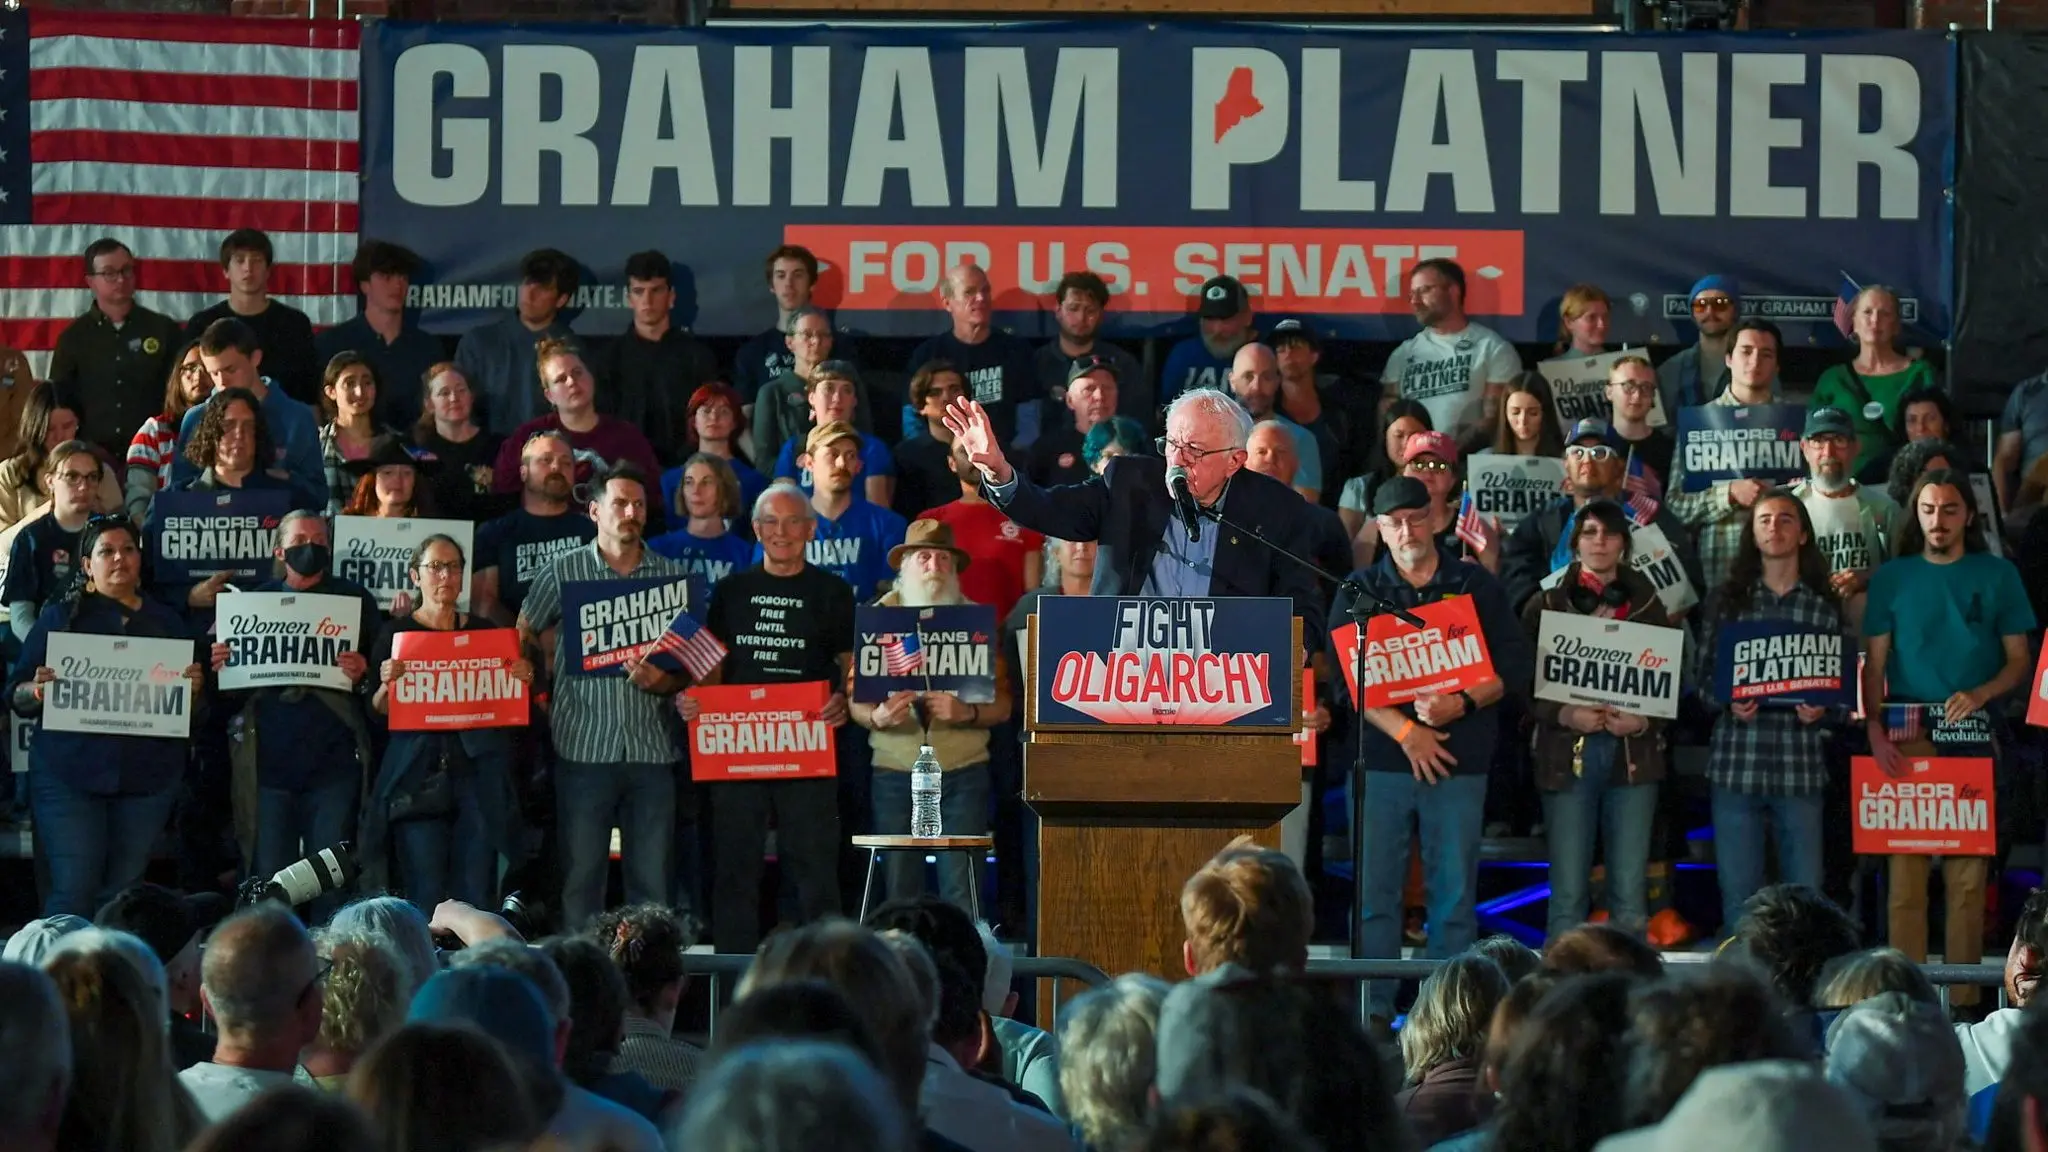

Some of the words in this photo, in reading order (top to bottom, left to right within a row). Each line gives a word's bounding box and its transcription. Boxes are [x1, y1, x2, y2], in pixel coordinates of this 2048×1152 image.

[393, 43, 1119, 208] GRAHAM
[1190, 47, 1921, 219] PLATNER
[1018, 242, 1149, 294] US.
[1173, 243, 1458, 297] SENAT
[1761, 301, 1827, 315] GRAHAM
[1404, 353, 1472, 377] GRAHAM
[1403, 367, 1470, 394] PLATNER
[1687, 428, 1776, 443] SENIORS
[1685, 440, 1800, 471] GRAHAM
[1481, 472, 1554, 490] Women
[164, 516, 259, 530] SENIORS
[261, 515, 279, 529] for
[161, 529, 277, 560] GRAHAM
[348, 538, 413, 560] Wome
[516, 535, 582, 557] GRAHAM
[805, 537, 860, 566] UAW
[340, 559, 418, 590] GRAH
[580, 579, 688, 630] GRAHAM
[750, 595, 803, 608] NOBODY'S
[760, 608, 786, 619] FREE
[230, 614, 310, 635] Women
[315, 616, 347, 637] for
[755, 622, 786, 633] UNTIL
[970, 631, 988, 643] for
[1113, 601, 1215, 650] FIGHT
[224, 635, 351, 668] GRAHAM
[736, 635, 806, 649] EVERYBODY'S
[753, 650, 779, 661] FREE
[1349, 627, 1443, 661] LABOR
[1447, 624, 1469, 638] for
[1553, 634, 1632, 664] Women
[1637, 648, 1668, 668] for
[1734, 634, 1841, 663] GRAHAM
[61, 656, 143, 681] Women
[149, 662, 179, 682] for
[592, 653, 614, 665] FOR
[1350, 634, 1484, 688] GRAHAM
[1733, 656, 1841, 686] PLATNER
[396, 668, 522, 704] GRAHAM
[1051, 651, 1272, 704] OLIGARCHY
[1544, 654, 1671, 699] GRAHAM
[1742, 685, 1764, 696] FOR
[52, 678, 184, 716] GRAHAM
[699, 711, 803, 723] EDUCATORS
[696, 720, 827, 755] GRAHAM
[1862, 782, 1955, 799] LABOR
[1958, 784, 1984, 800] for
[1859, 798, 1988, 831] GRAHAM
